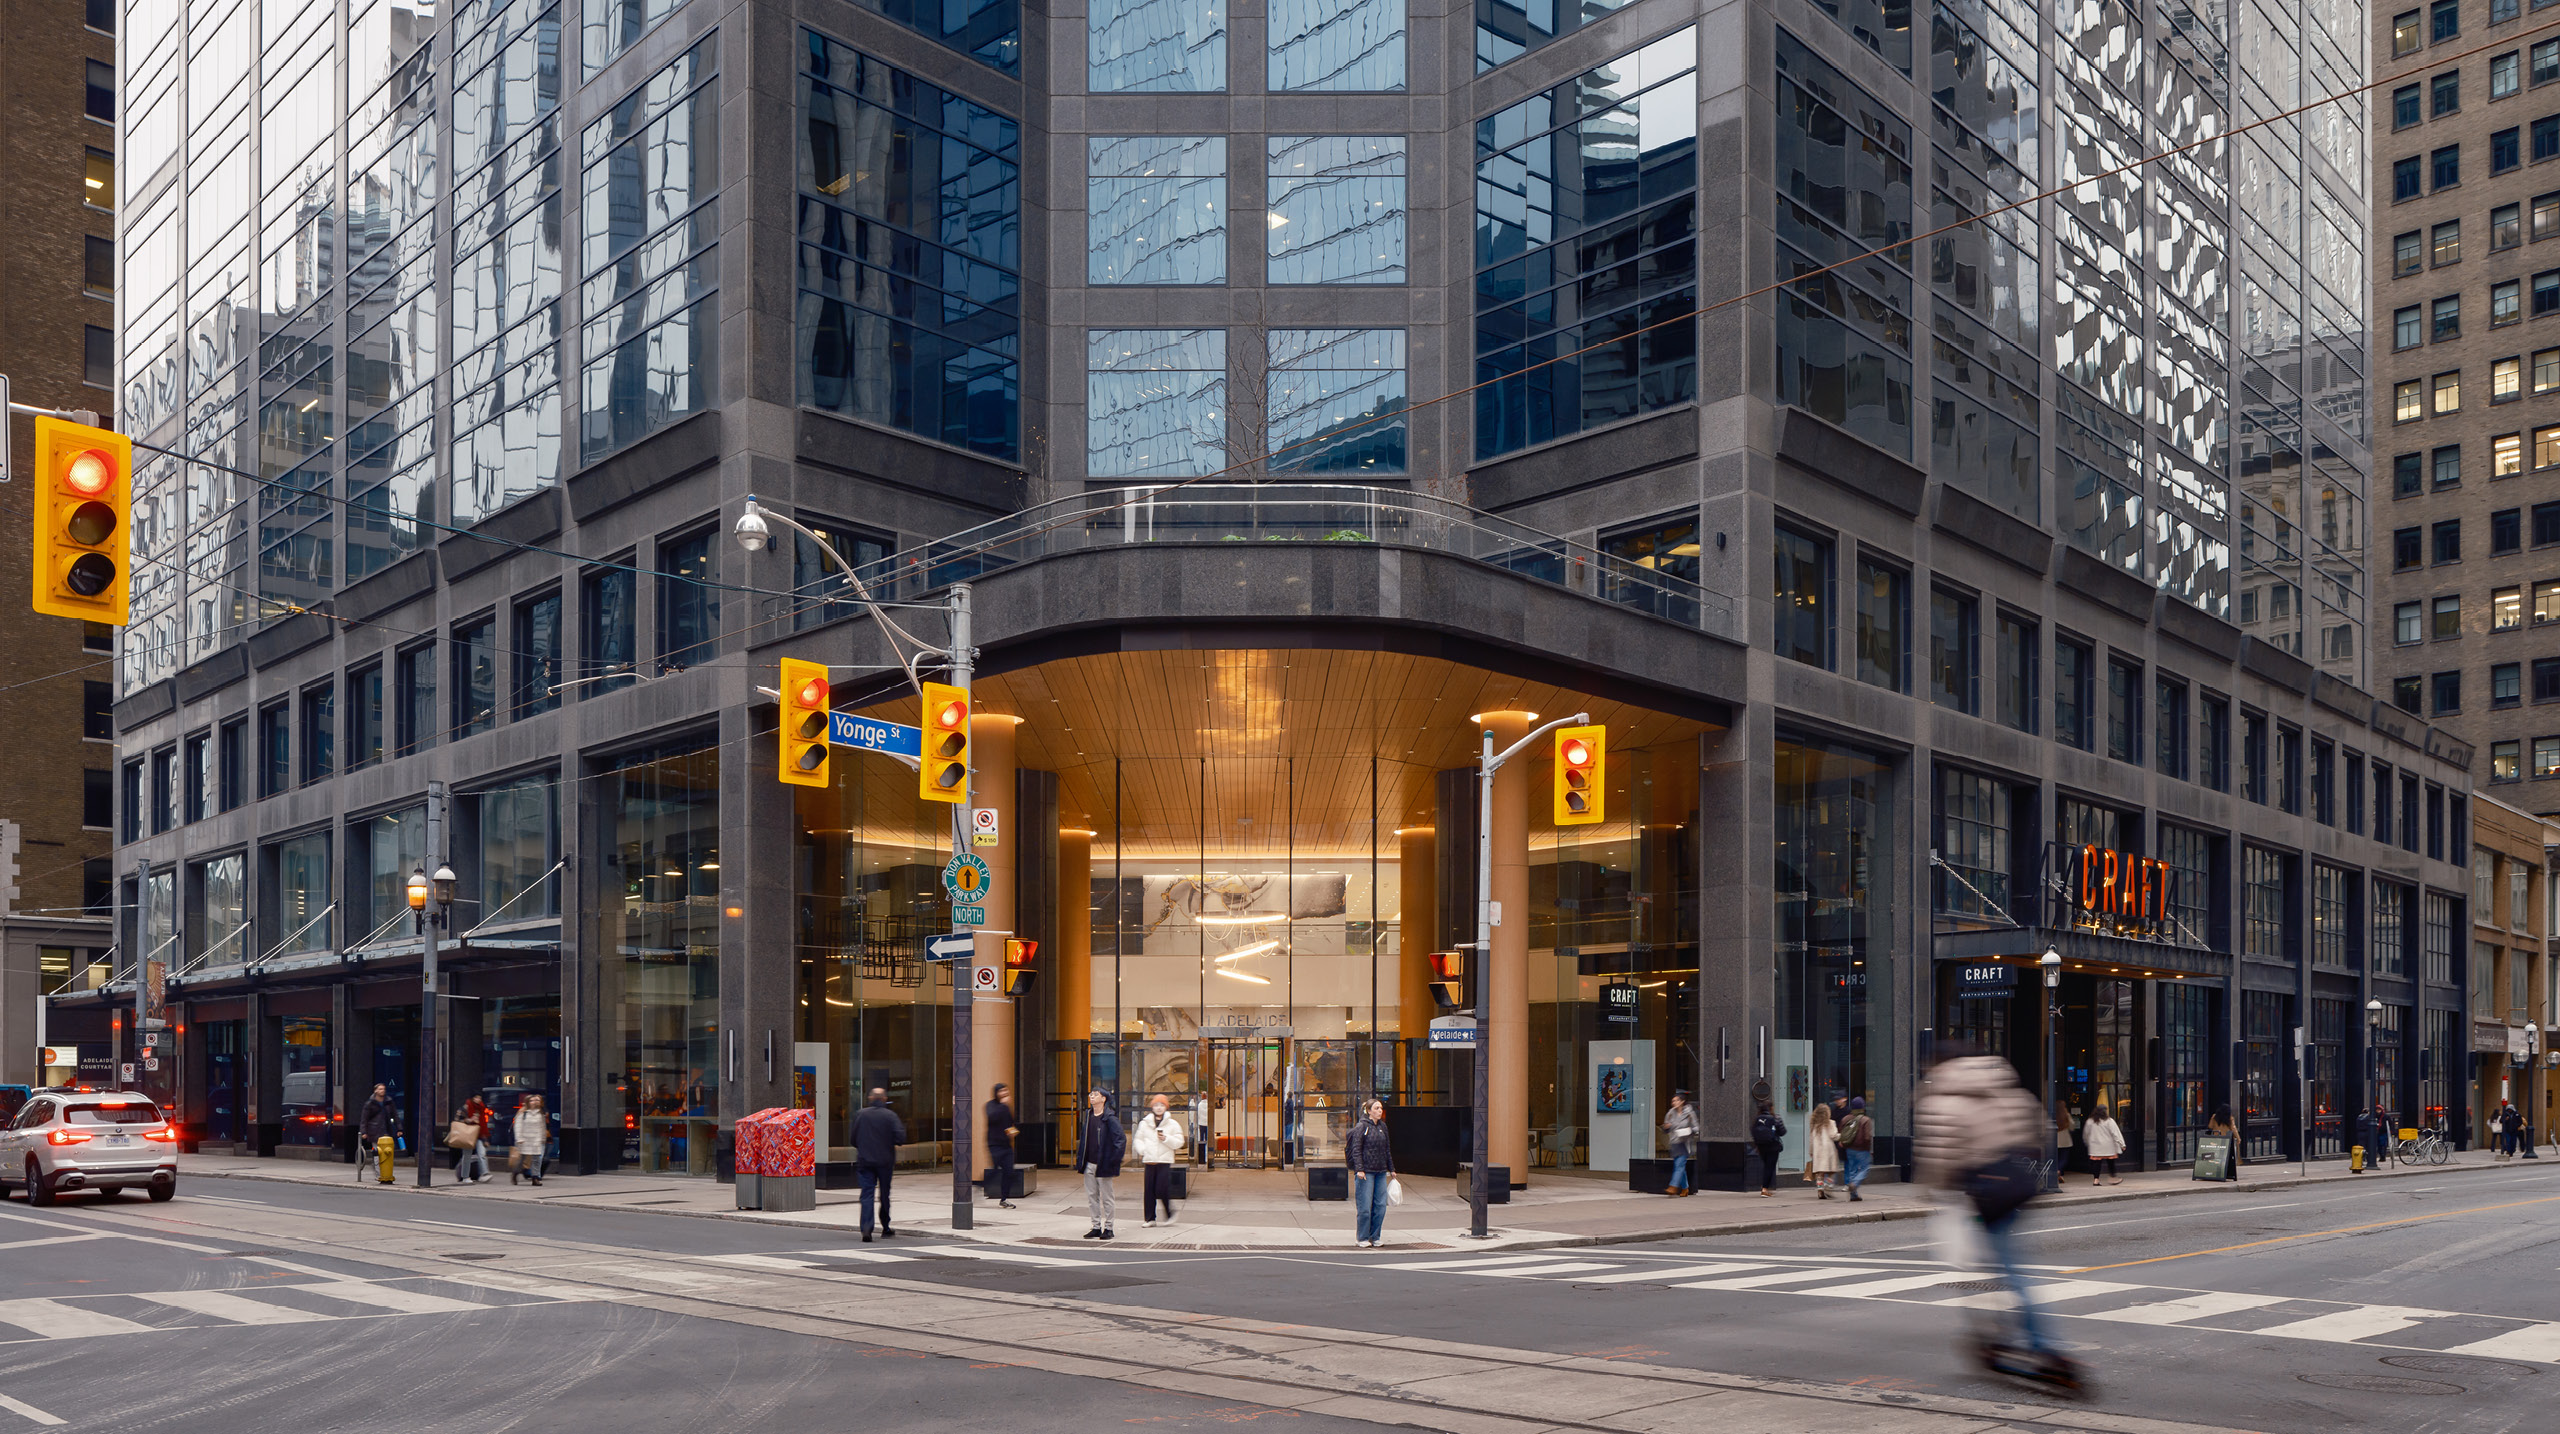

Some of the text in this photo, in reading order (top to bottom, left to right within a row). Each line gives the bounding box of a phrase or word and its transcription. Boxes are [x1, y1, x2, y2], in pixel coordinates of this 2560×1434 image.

[835, 715, 901, 748] Yonge St
[946, 853, 990, 878] DON VALLEY
[2082, 843, 2170, 921] CRAFT
[949, 884, 986, 903] PARKWAY
[955, 907, 983, 923] NORTH
[1965, 967, 2004, 981] CRAFT
[1610, 988, 1637, 1004] CRAFT
[1217, 1014, 1288, 1027] ADELAIDE
[1431, 1030, 1462, 1041] Adelaide
